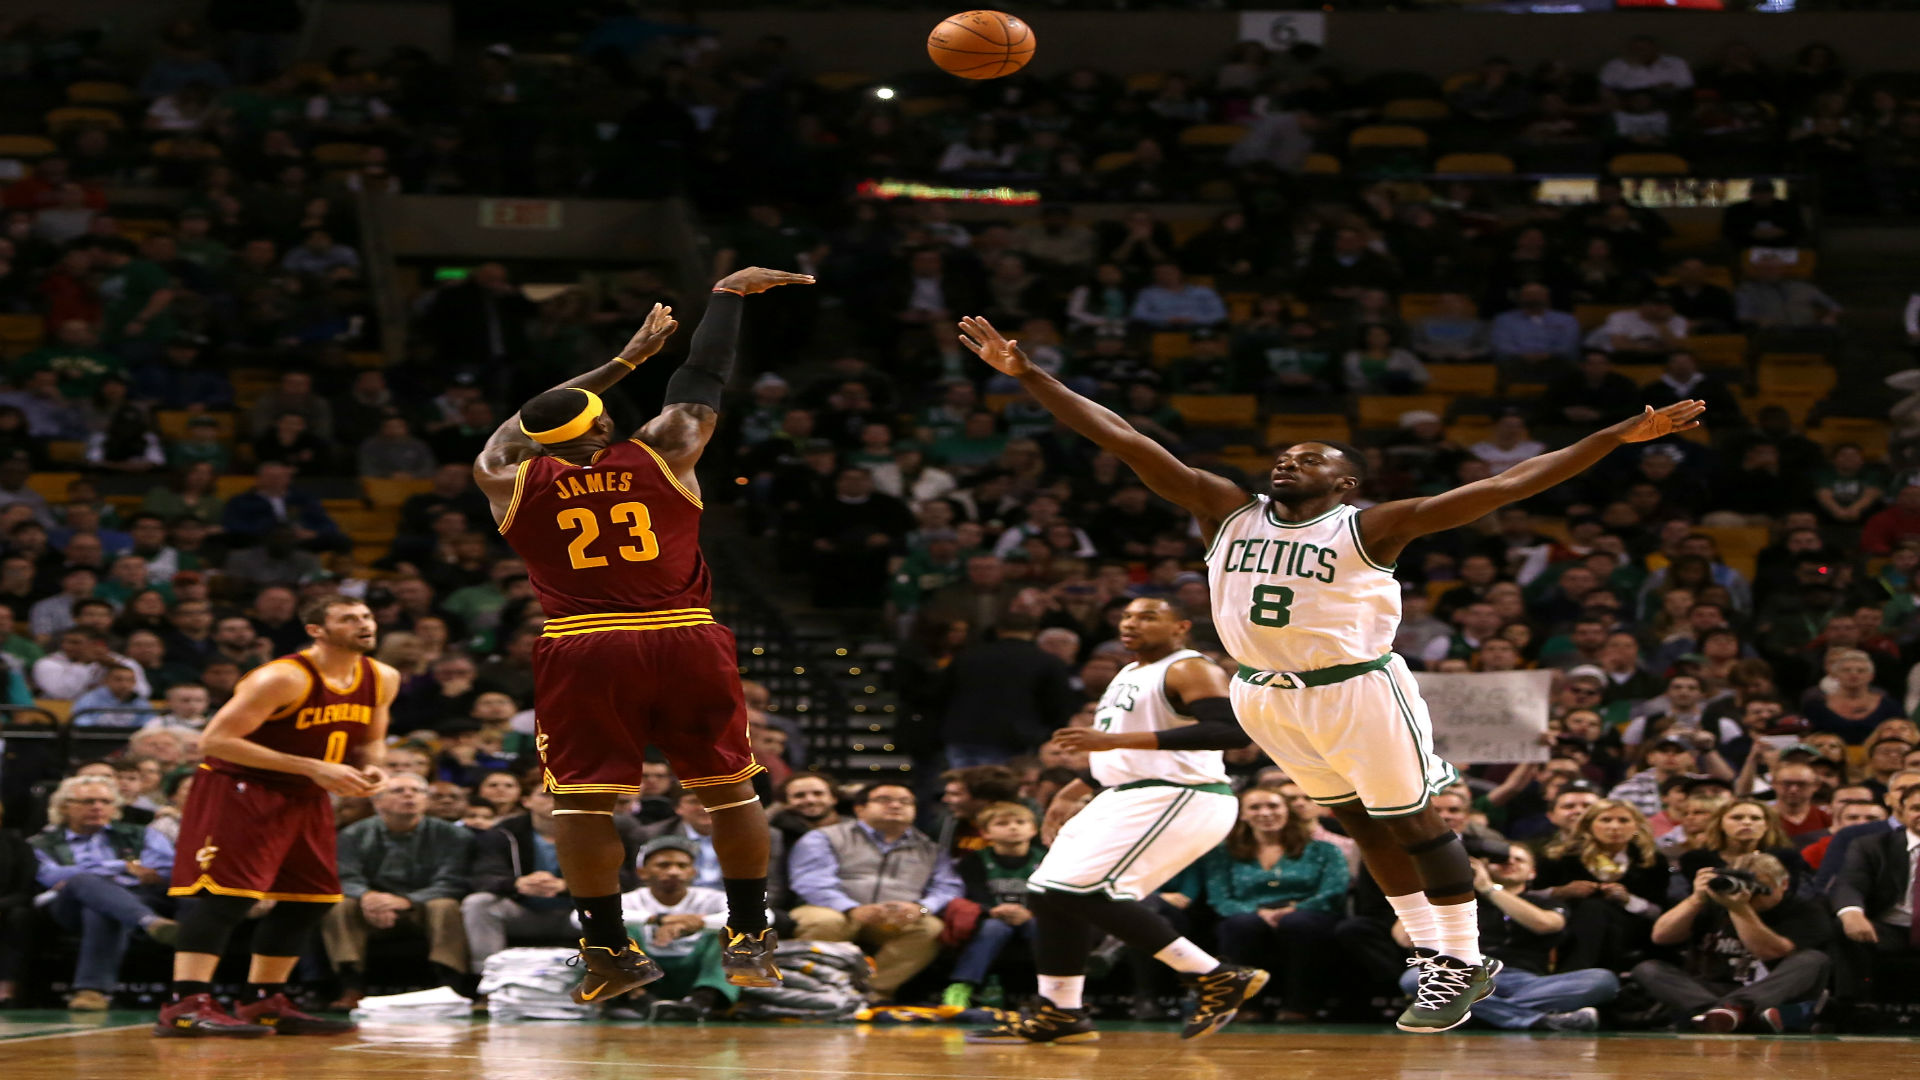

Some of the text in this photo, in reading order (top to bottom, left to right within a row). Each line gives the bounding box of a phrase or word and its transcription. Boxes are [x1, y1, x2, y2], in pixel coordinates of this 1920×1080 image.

[1271, 15, 1299, 44] 6
[555, 472, 633, 499] JAMES
[556, 502, 660, 570] 23
[1225, 539, 1338, 583] CELTICS
[1250, 584, 1295, 628] 8
[324, 731, 349, 764] 0
